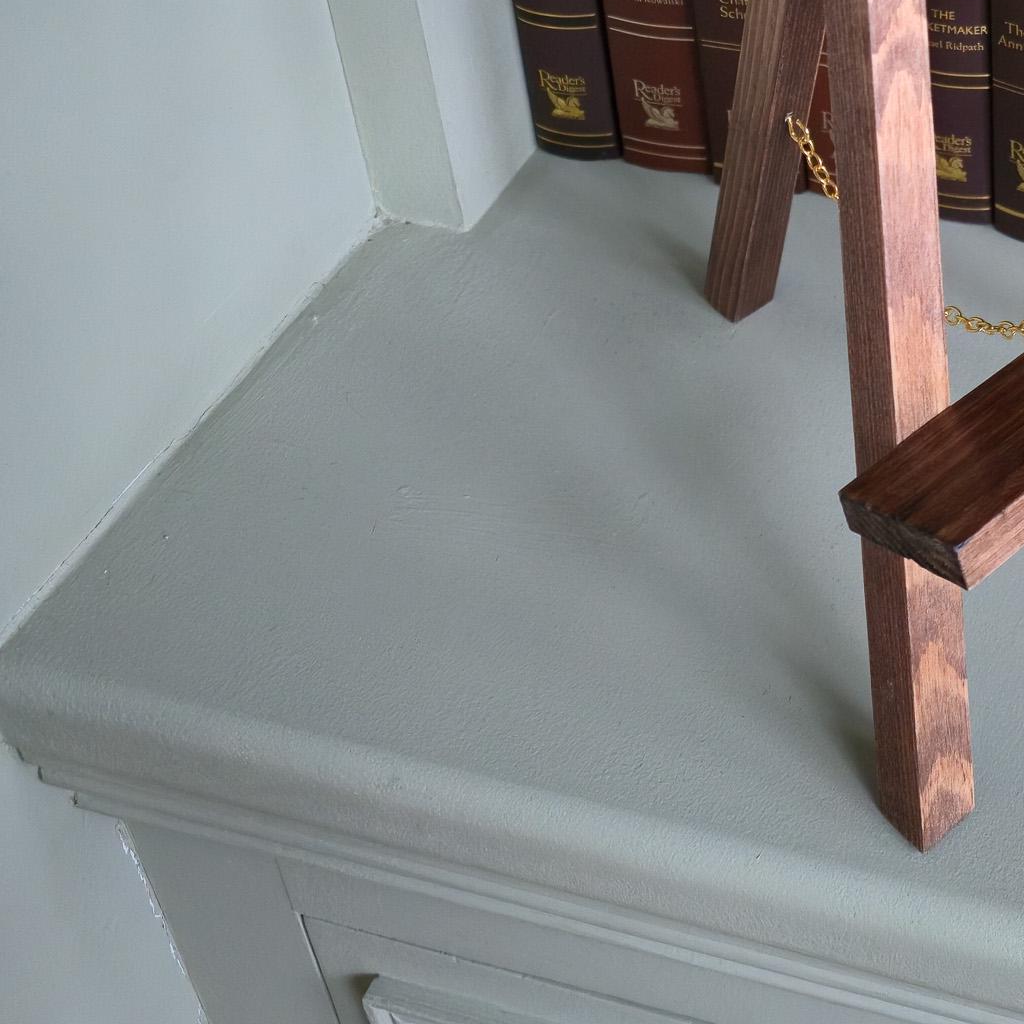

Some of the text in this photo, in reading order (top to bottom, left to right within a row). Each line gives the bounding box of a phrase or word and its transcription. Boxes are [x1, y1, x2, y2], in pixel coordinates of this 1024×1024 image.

[931, 9, 956, 20] THE
[946, 41, 984, 53] Ridpath
[538, 69, 586, 89] Reader's
[632, 79, 681, 97] Reader's
